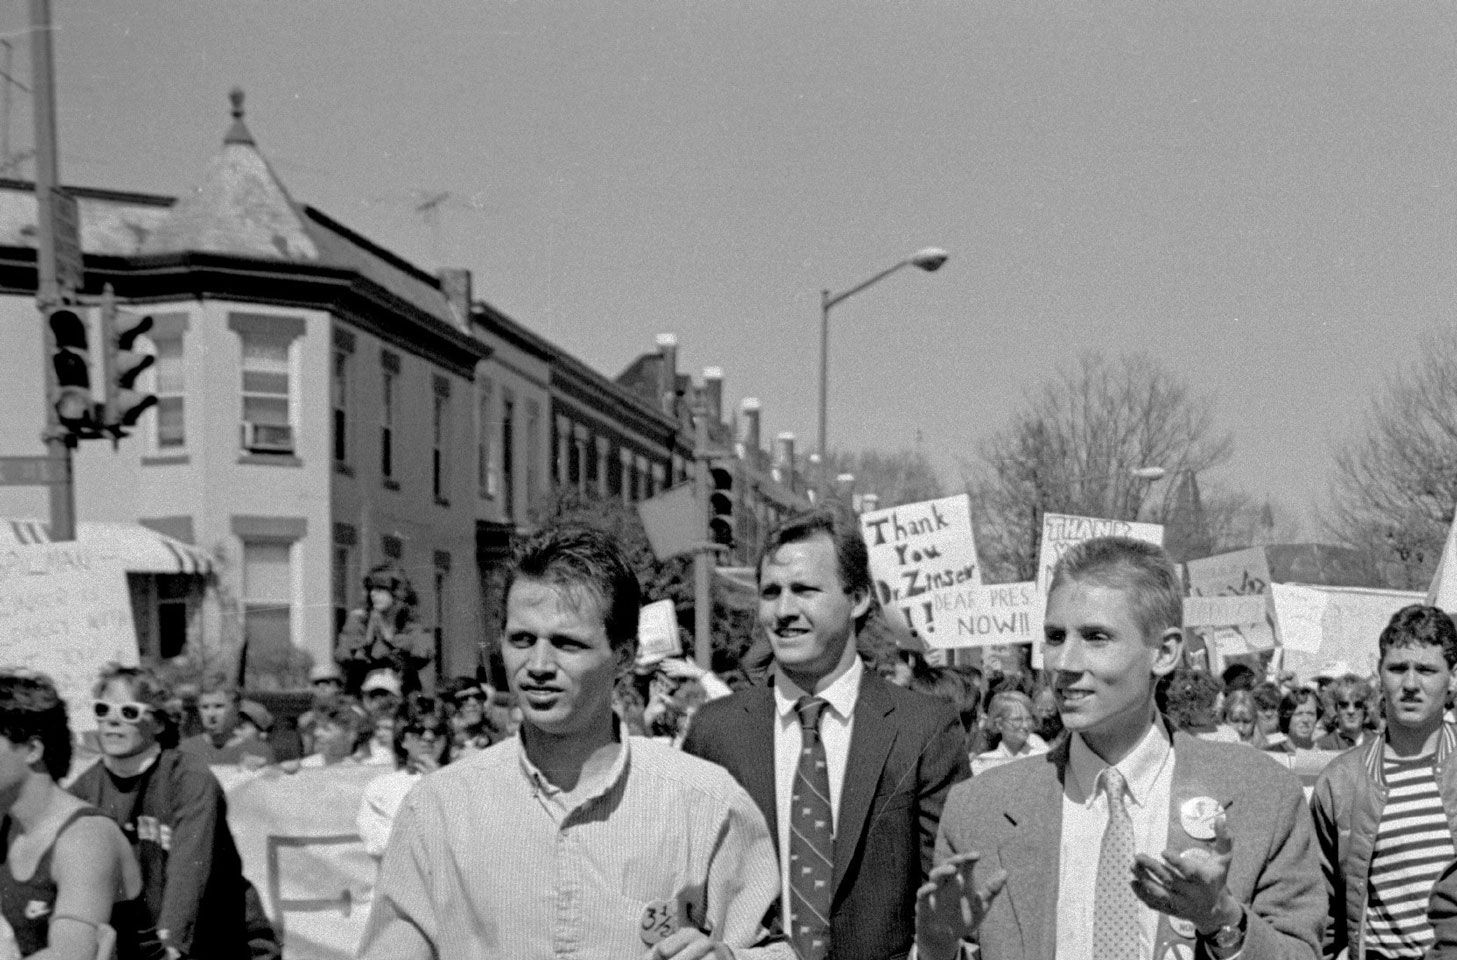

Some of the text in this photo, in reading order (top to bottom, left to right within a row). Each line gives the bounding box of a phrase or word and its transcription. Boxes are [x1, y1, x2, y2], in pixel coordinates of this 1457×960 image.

[866, 503, 949, 546] Thank
[1045, 515, 1132, 541] THANK
[894, 544, 941, 566] You
[876, 564, 974, 605] Dr Zinser
[934, 586, 1030, 612] DEAF PRES
